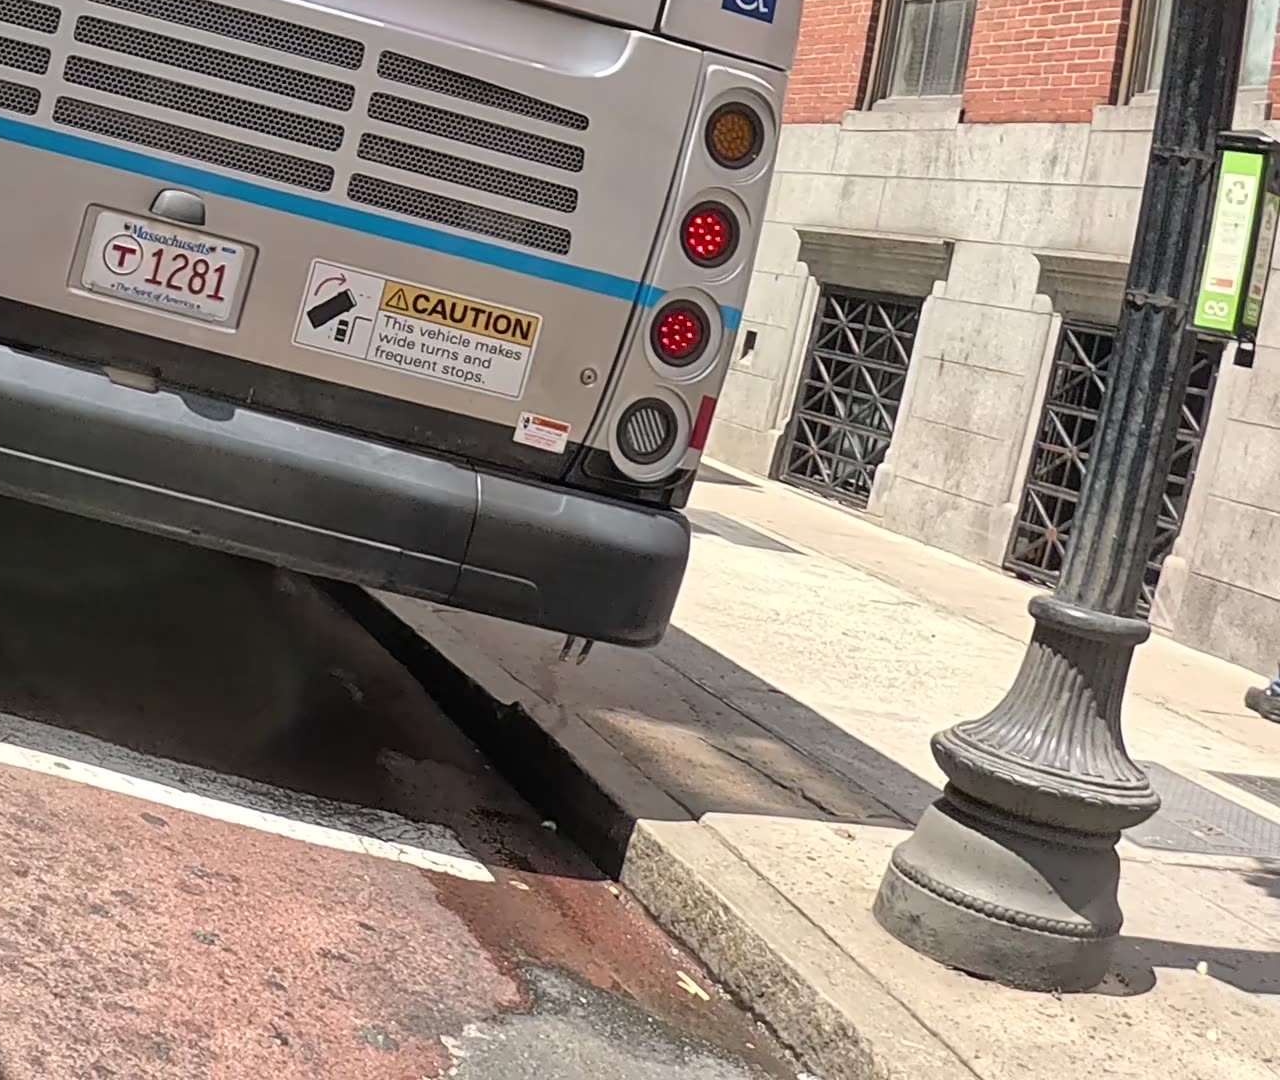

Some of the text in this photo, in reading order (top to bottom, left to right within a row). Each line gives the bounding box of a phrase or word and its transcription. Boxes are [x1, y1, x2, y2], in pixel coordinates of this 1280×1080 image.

[130, 224, 211, 255] Massachusetts
[144, 248, 227, 302] 1281
[383, 314, 522, 361] This vehicle makes
[412, 294, 532, 340] CAUTION
[374, 345, 486, 384] frequent stops.
[379, 332, 492, 369] wide turns and
